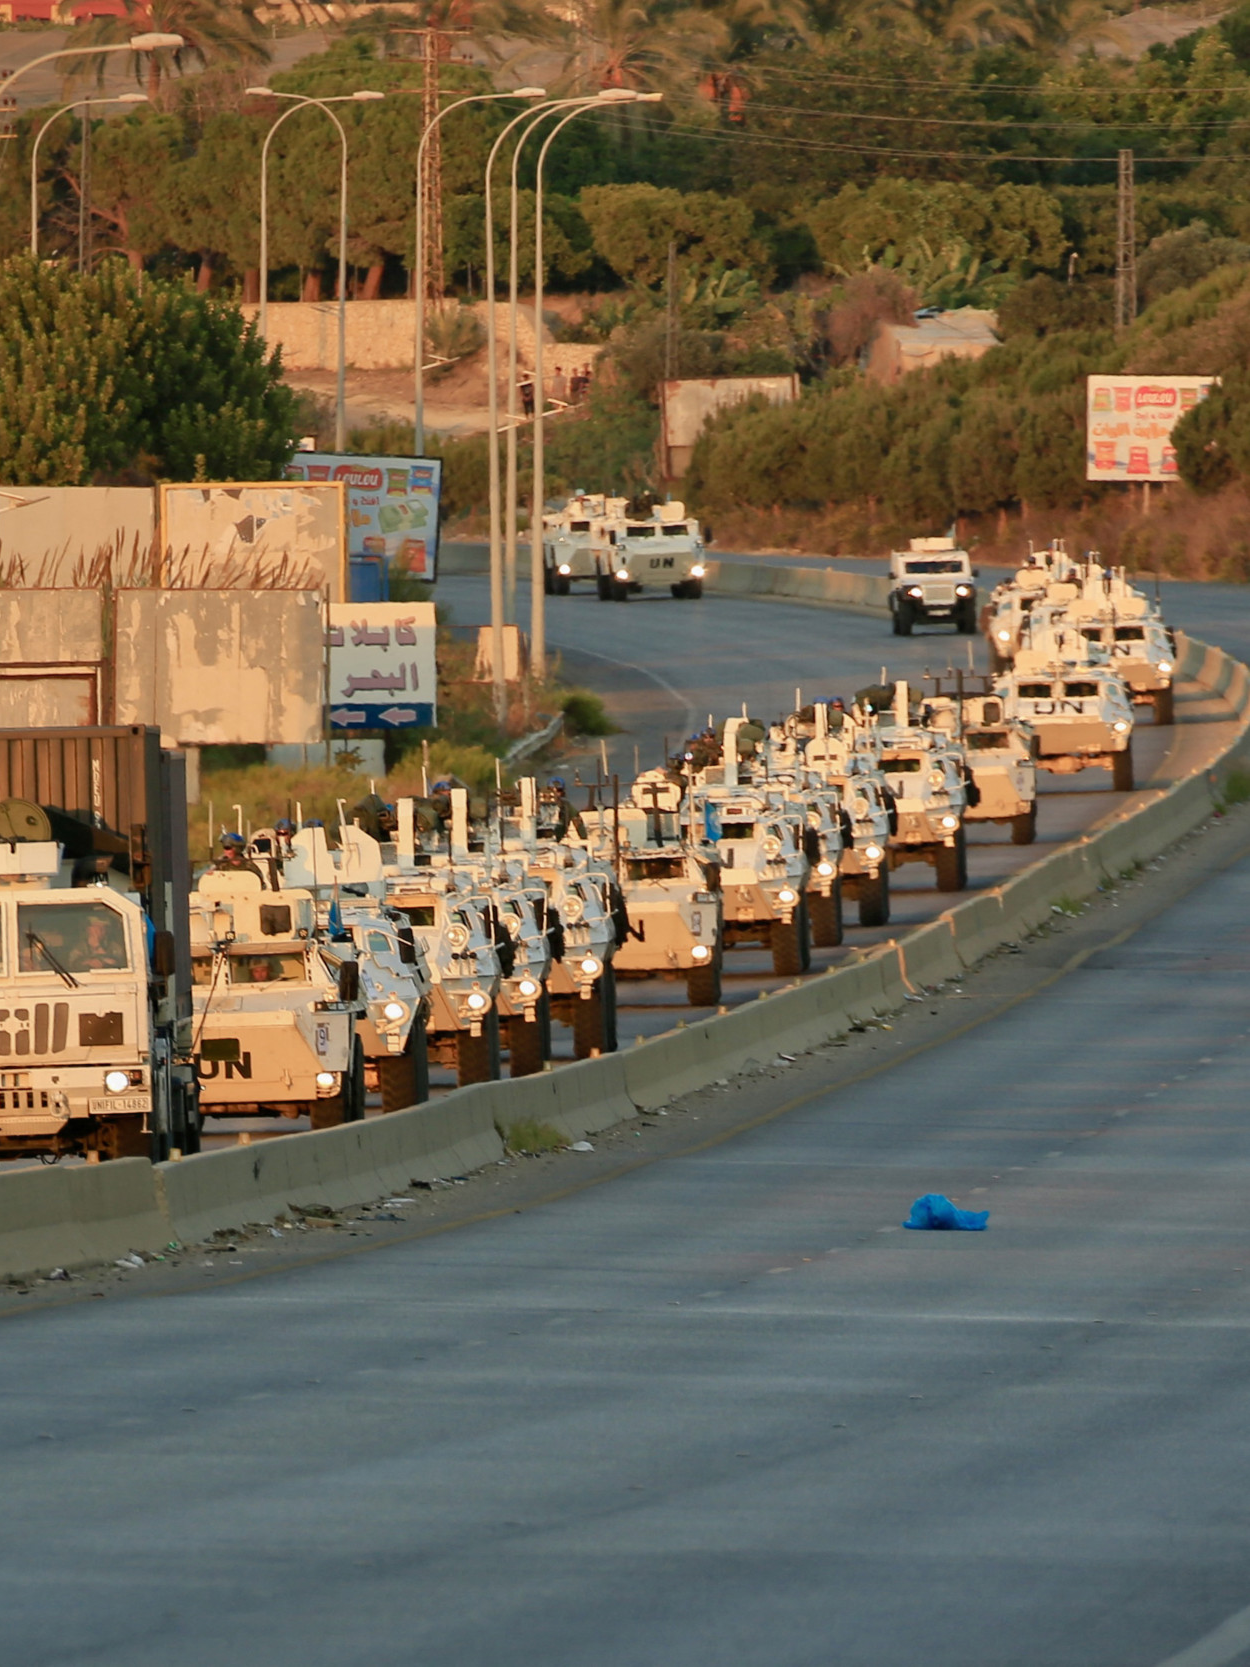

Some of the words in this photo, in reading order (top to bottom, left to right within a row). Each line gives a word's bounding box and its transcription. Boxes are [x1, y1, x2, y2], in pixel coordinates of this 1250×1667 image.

[650, 557, 674, 569] UN
[1034, 700, 1084, 715] UN
[194, 1052, 252, 1079] UN
